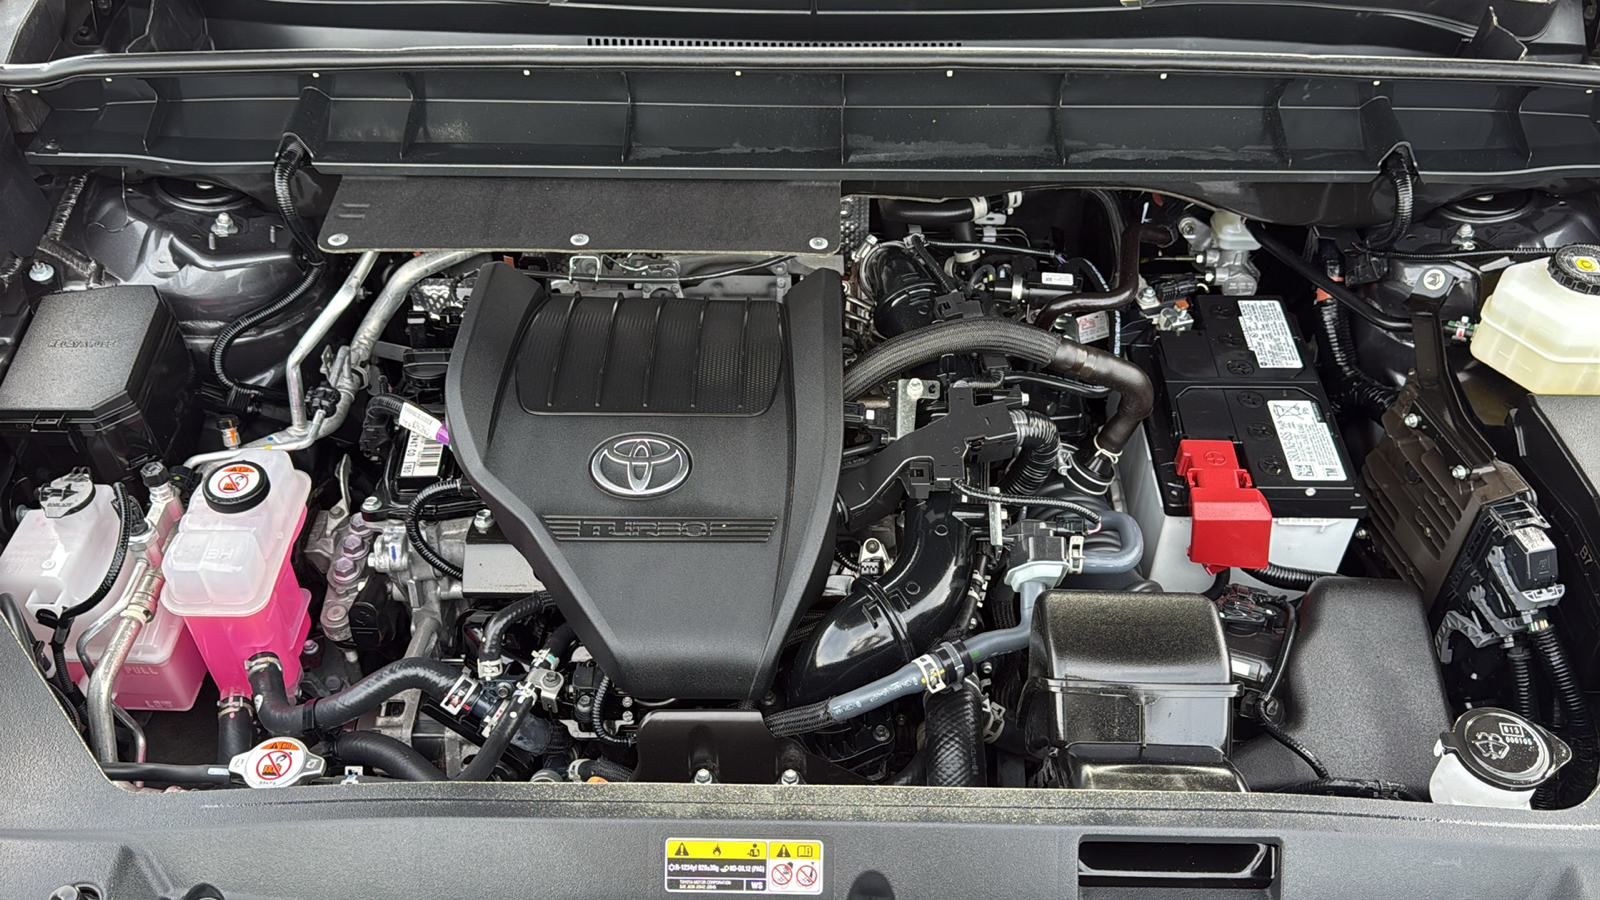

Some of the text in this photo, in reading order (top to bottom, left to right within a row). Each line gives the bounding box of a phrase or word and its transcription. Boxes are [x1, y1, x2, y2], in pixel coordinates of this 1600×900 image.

[583, 520, 708, 538] TURBO
[124, 666, 158, 675] FULL
[145, 700, 173, 708] LOW
[751, 881, 763, 890] WS
